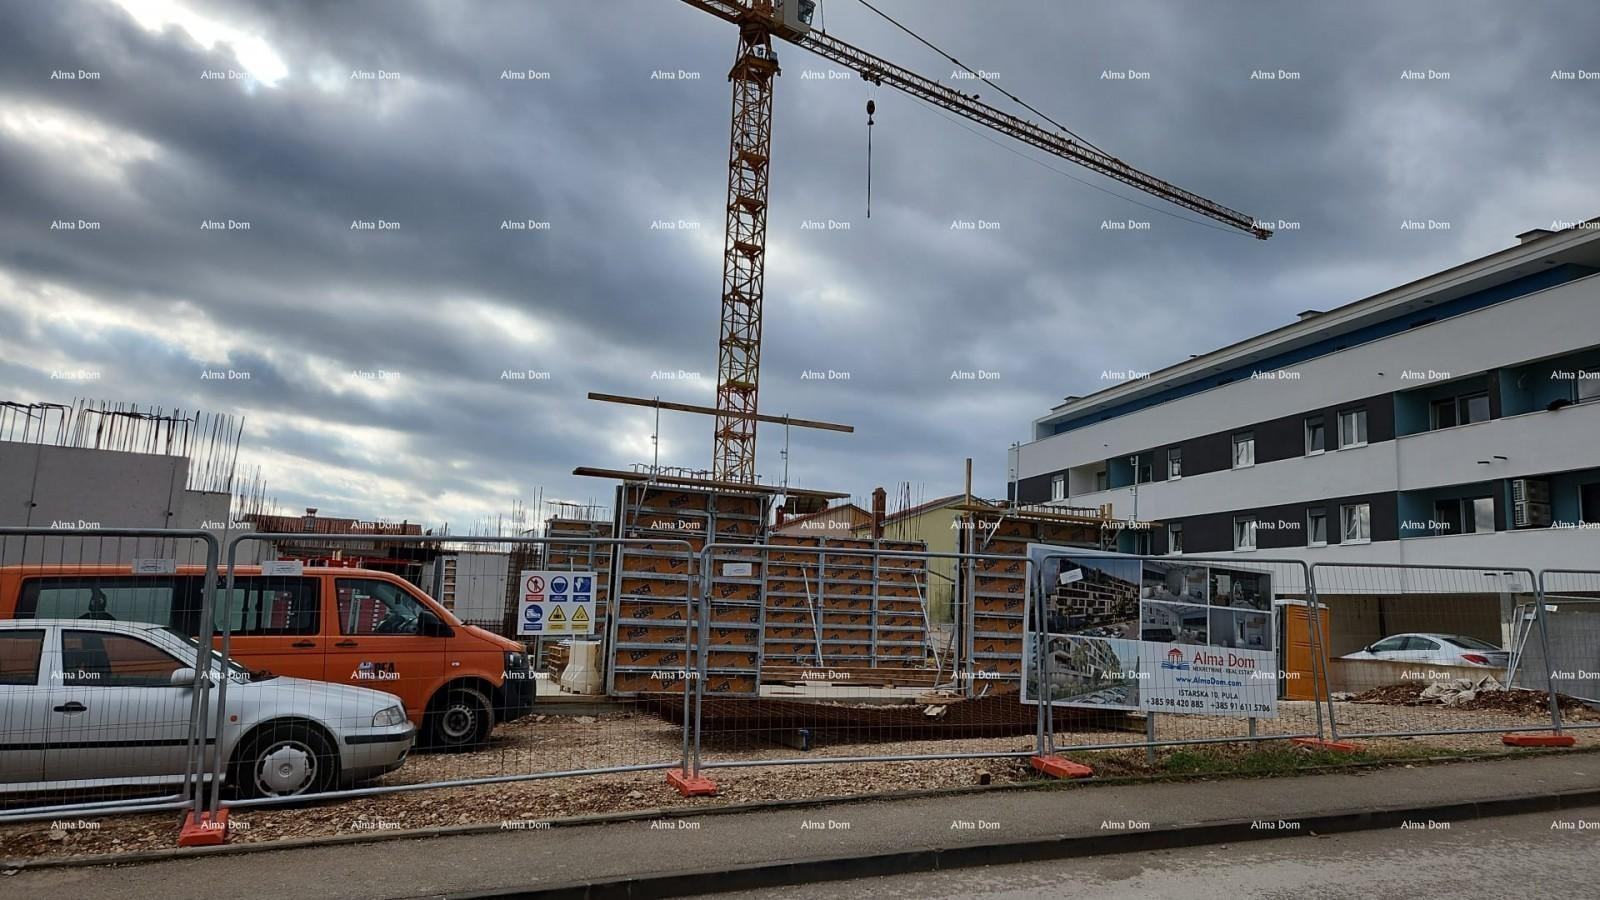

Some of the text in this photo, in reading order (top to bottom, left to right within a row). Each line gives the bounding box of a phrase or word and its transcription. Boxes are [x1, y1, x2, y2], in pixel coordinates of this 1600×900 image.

[1193, 651, 1255, 669] Alma Dom
[1192, 665, 1222, 674] NEKRETNINE
[1176, 675, 1242, 687] www.AlmaDom.com
[1178, 689, 1209, 698] ISTARSKA
[1221, 691, 1239, 700] PULA
[1144, 697, 1204, 708] +385 98 420 885
[1210, 701, 1271, 712] +385 91 611 5706
